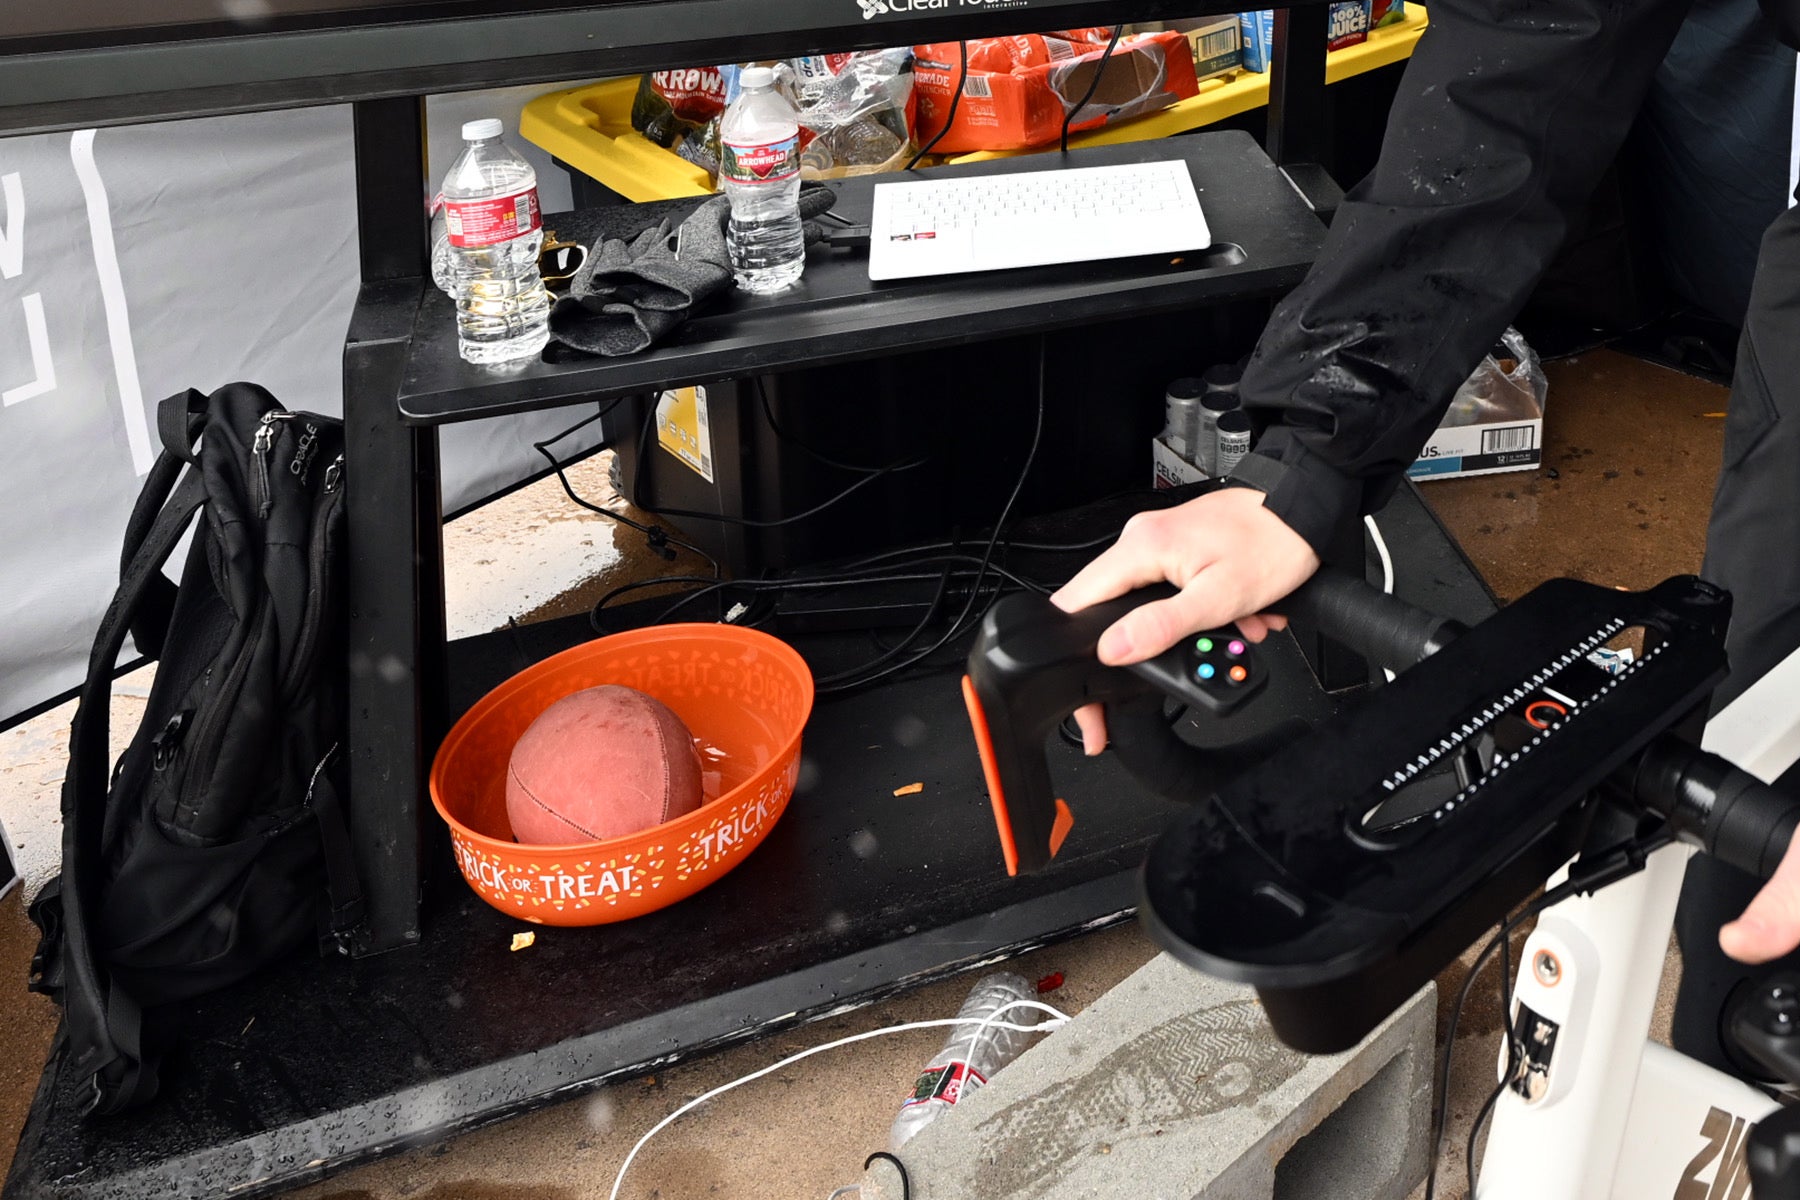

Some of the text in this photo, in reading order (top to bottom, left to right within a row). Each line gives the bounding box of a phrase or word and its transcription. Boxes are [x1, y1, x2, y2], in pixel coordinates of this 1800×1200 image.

[1327, 13, 1367, 39] JUICE
[738, 152, 784, 166] ARROWHEAD
[700, 793, 769, 860] TRICK
[453, 838, 635, 899] TRICK OR TREAT
